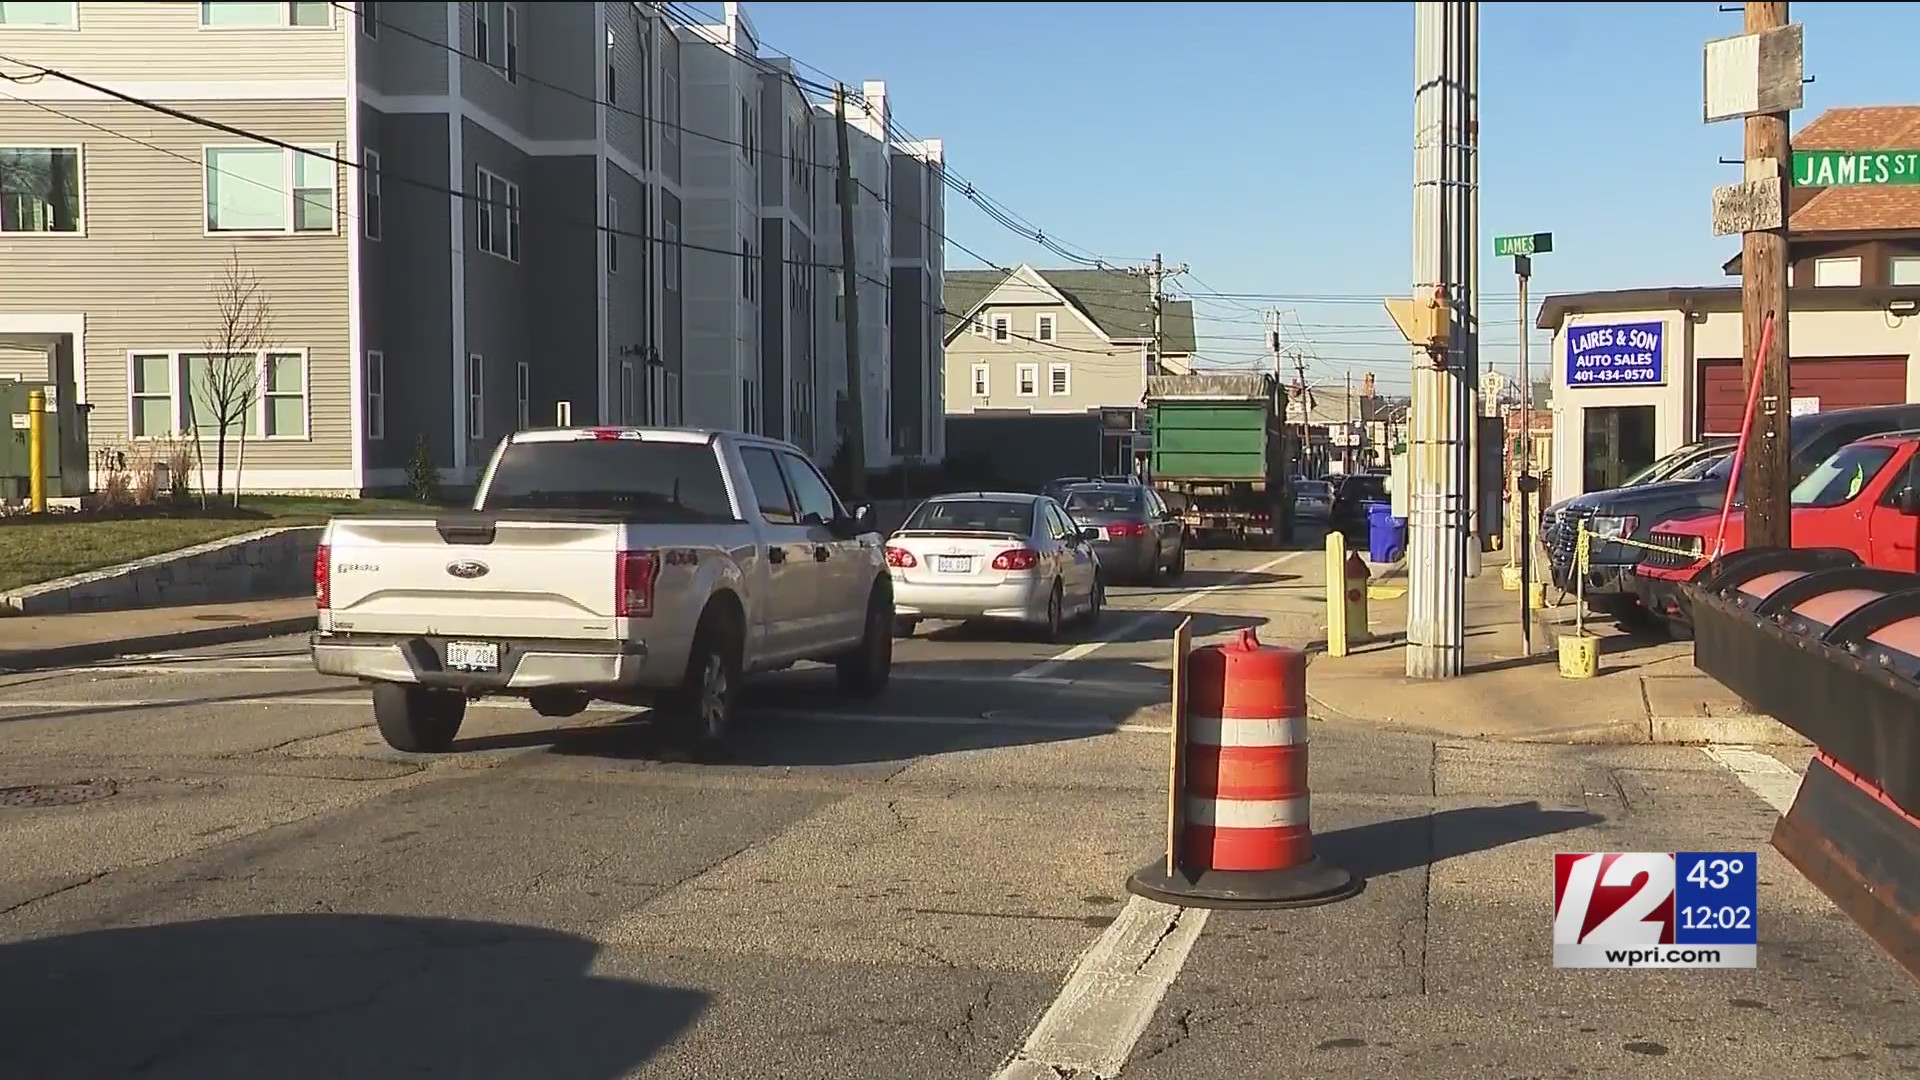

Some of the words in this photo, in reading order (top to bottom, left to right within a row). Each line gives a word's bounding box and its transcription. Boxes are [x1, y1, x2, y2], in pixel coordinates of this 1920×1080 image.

[1797, 154, 1889, 185] JAMES
[1894, 154, 1918, 175] ST
[1500, 236, 1535, 254] JAMES
[1571, 328, 1613, 354] LAIRES
[1616, 329, 1627, 346] &
[1628, 329, 1658, 351] SON
[1576, 354, 1612, 367] AUTO
[1613, 353, 1652, 366] SALES
[1574, 368, 1654, 381] 401-434-0570
[475, 649, 495, 664] 206
